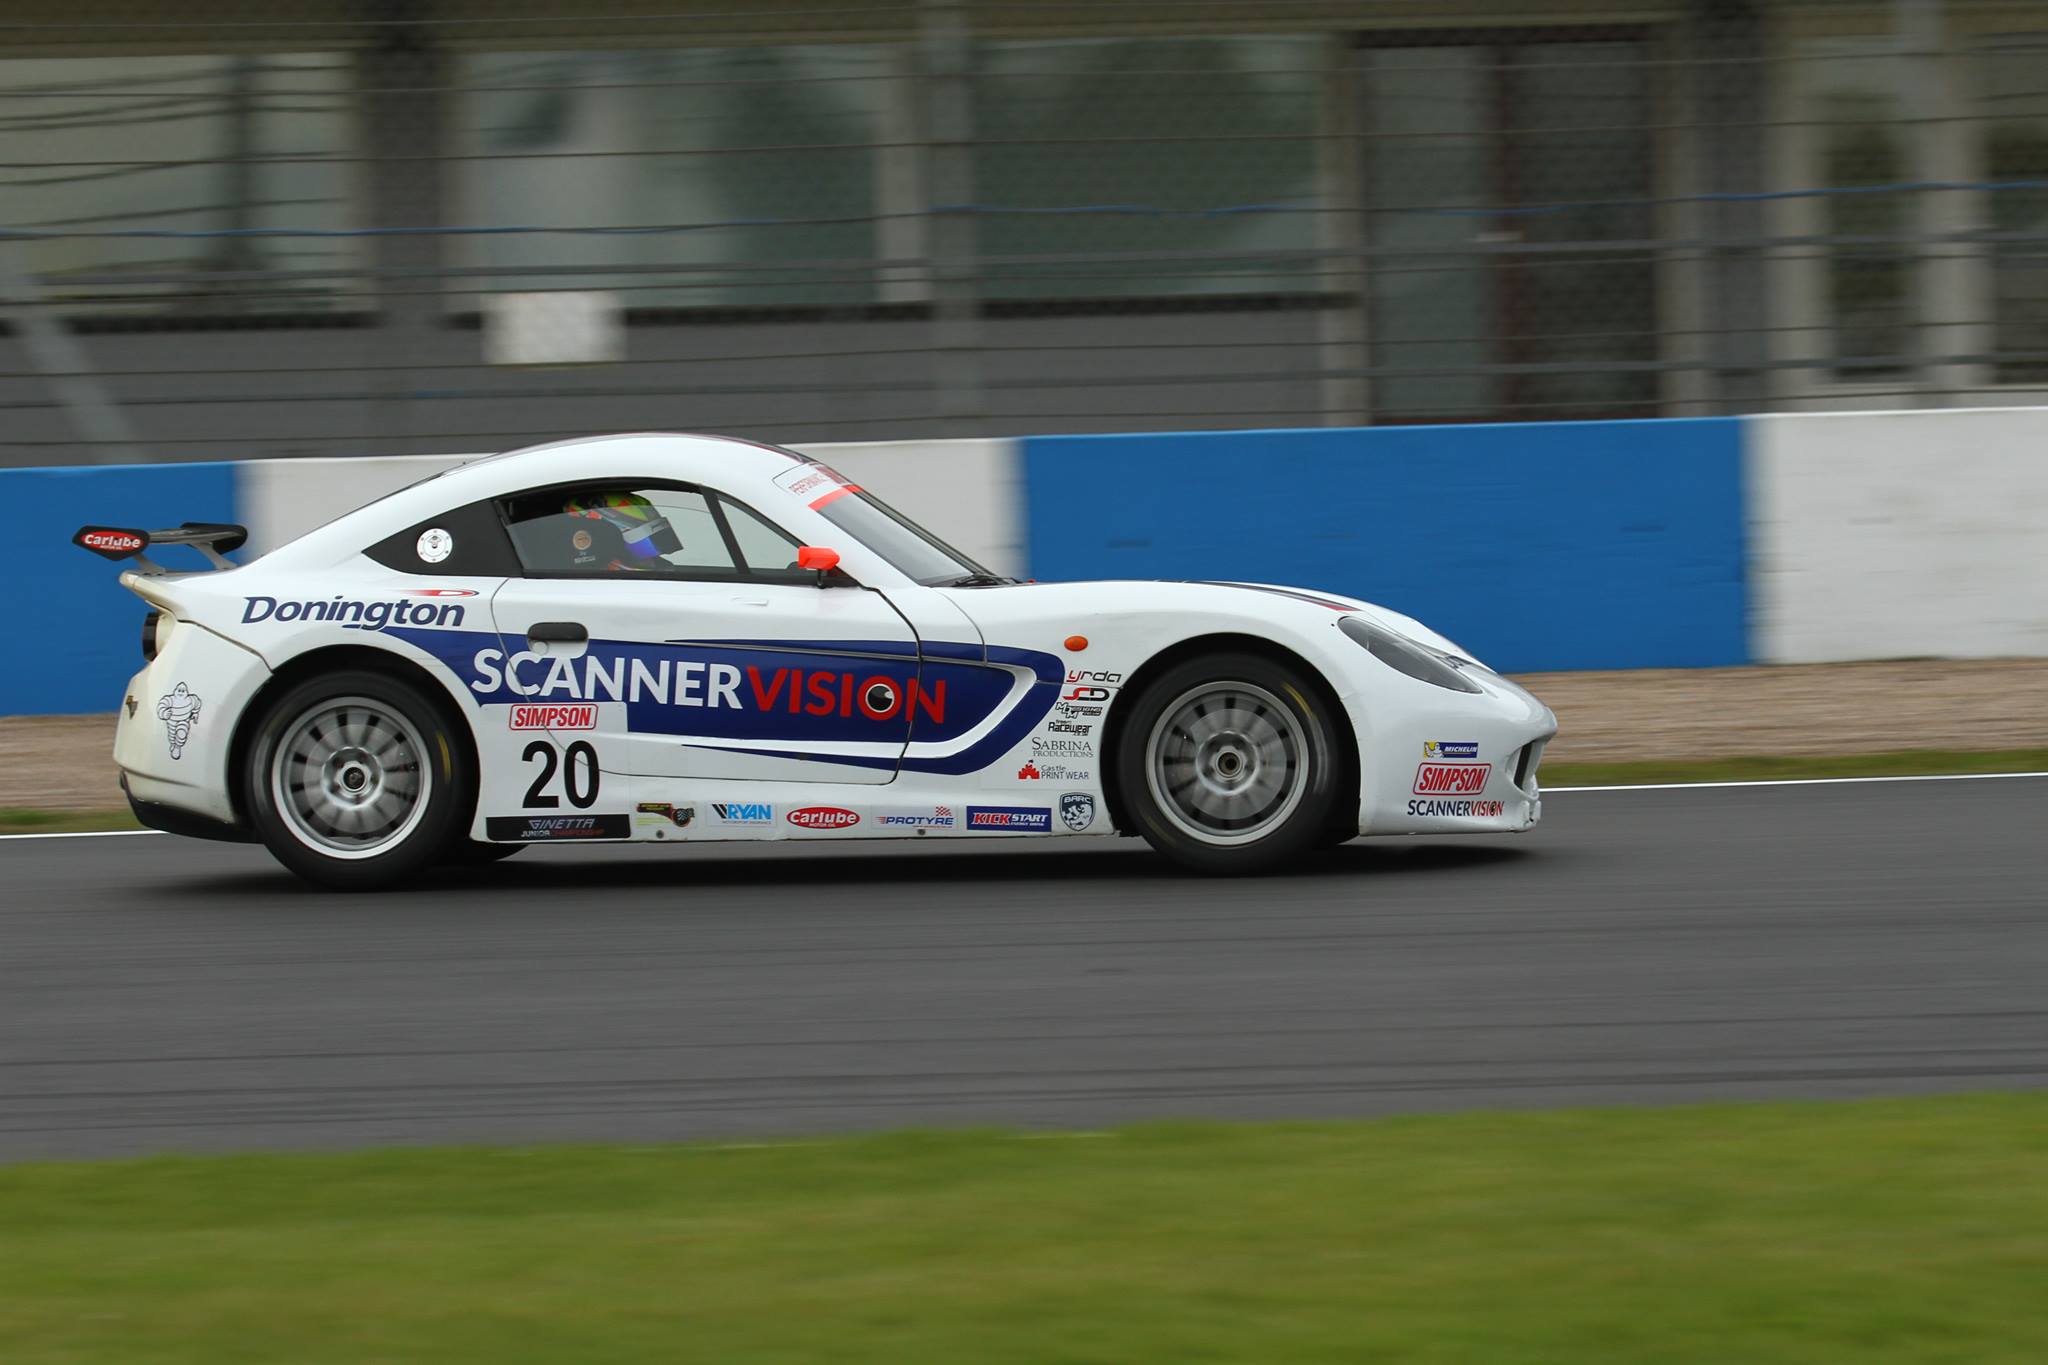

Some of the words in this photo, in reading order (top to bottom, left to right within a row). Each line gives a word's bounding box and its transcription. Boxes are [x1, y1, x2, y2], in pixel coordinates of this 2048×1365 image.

[84, 534, 141, 549] Carlube
[241, 595, 466, 631] Donington
[1066, 670, 1122, 683] yrda
[514, 707, 593, 727] SIMPSON
[1033, 750, 1094, 758] PRODUCTIONS
[1444, 745, 1478, 753] MICHELIN
[521, 740, 600, 809] 20
[1041, 771, 1064, 780] PRINT
[1066, 772, 1089, 780] WEAR
[1419, 767, 1487, 791] SIMPSON
[1063, 795, 1092, 804] BARC
[727, 804, 771, 820] RYAN
[789, 811, 857, 824] Carlube
[972, 812, 1011, 825] KICK
[1011, 813, 1048, 823] START
[528, 818, 595, 830] GINETTA
[884, 816, 954, 825] PROTYRE
[521, 830, 551, 838] JUNIOR
